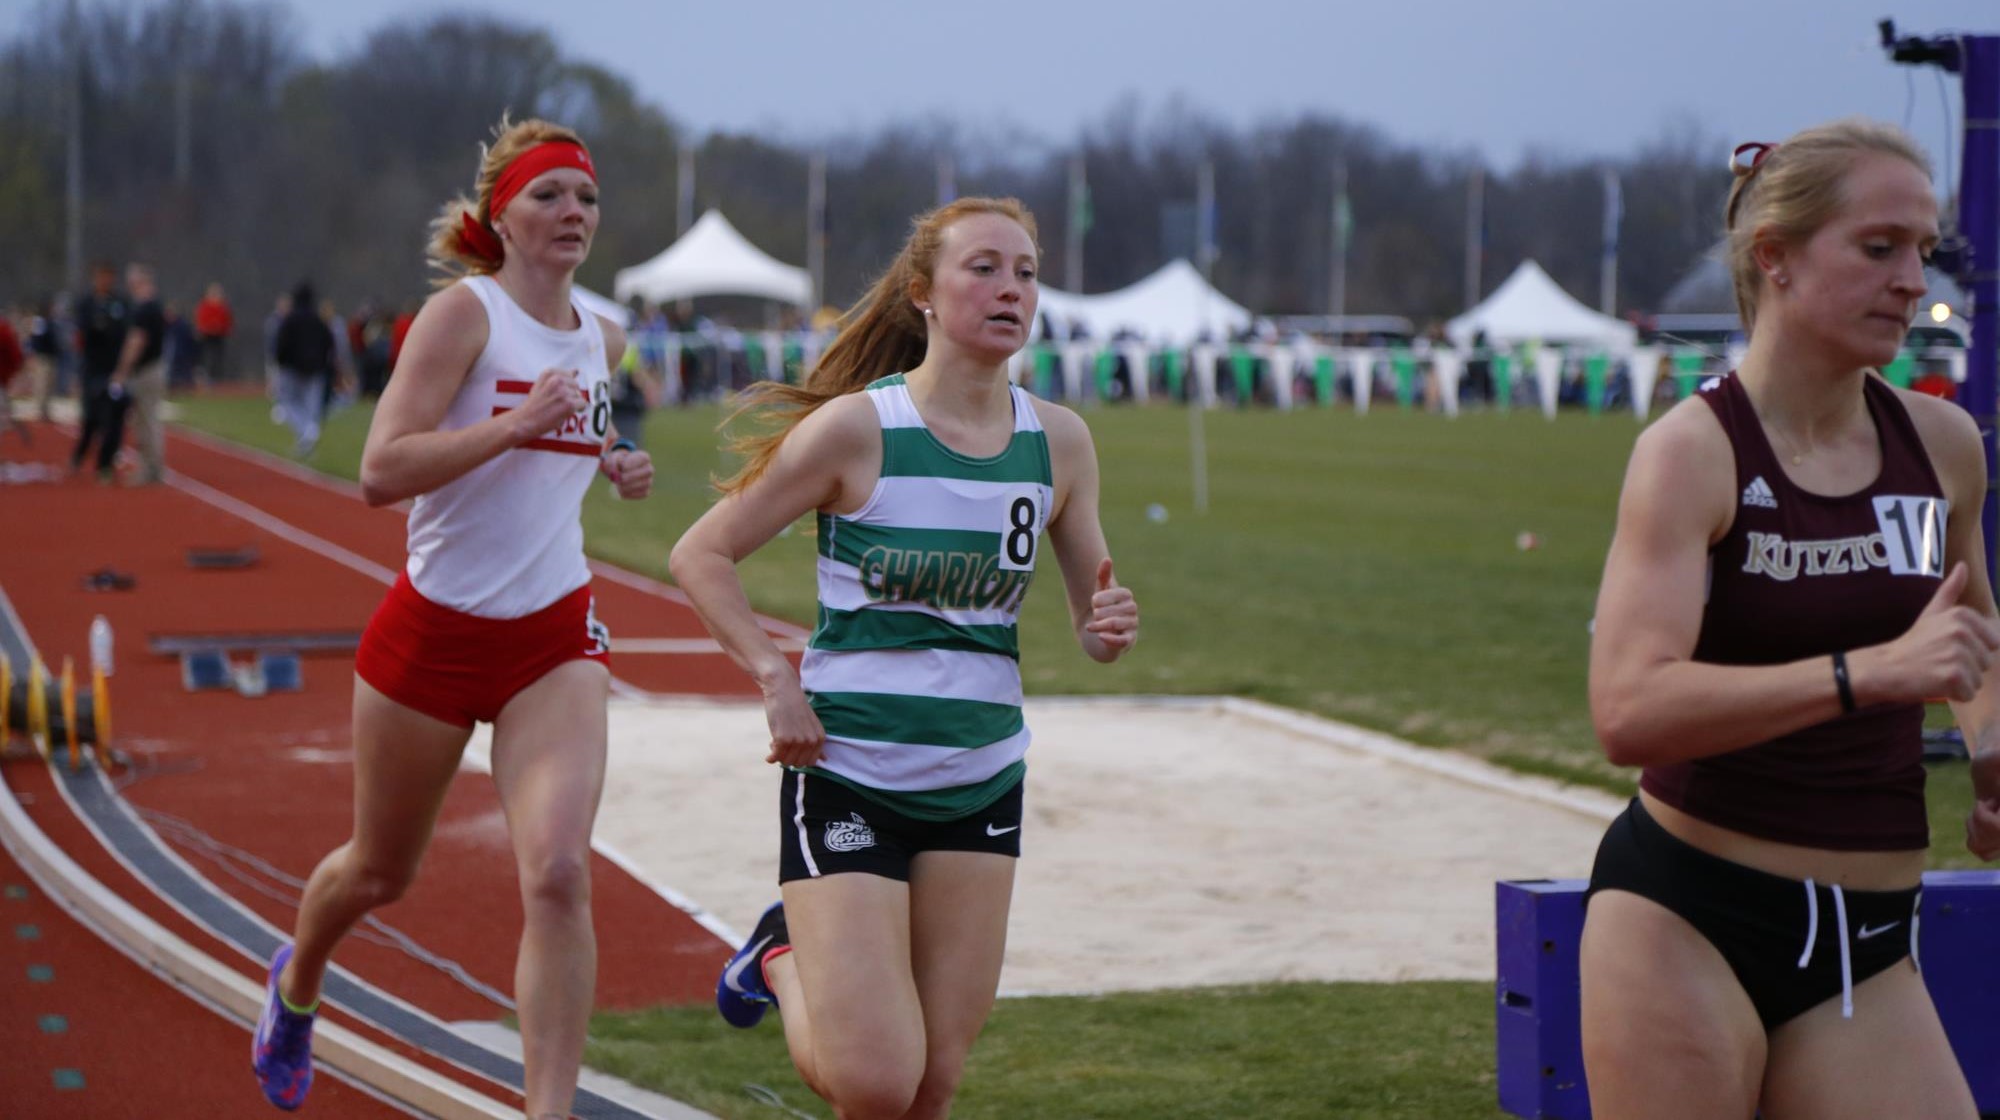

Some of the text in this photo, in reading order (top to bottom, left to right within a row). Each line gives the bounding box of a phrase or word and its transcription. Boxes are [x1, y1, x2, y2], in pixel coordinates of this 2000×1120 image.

[1007, 497, 1035, 566] 8
[1885, 499, 1942, 572] 10
[834, 832, 872, 843] 49ERS
